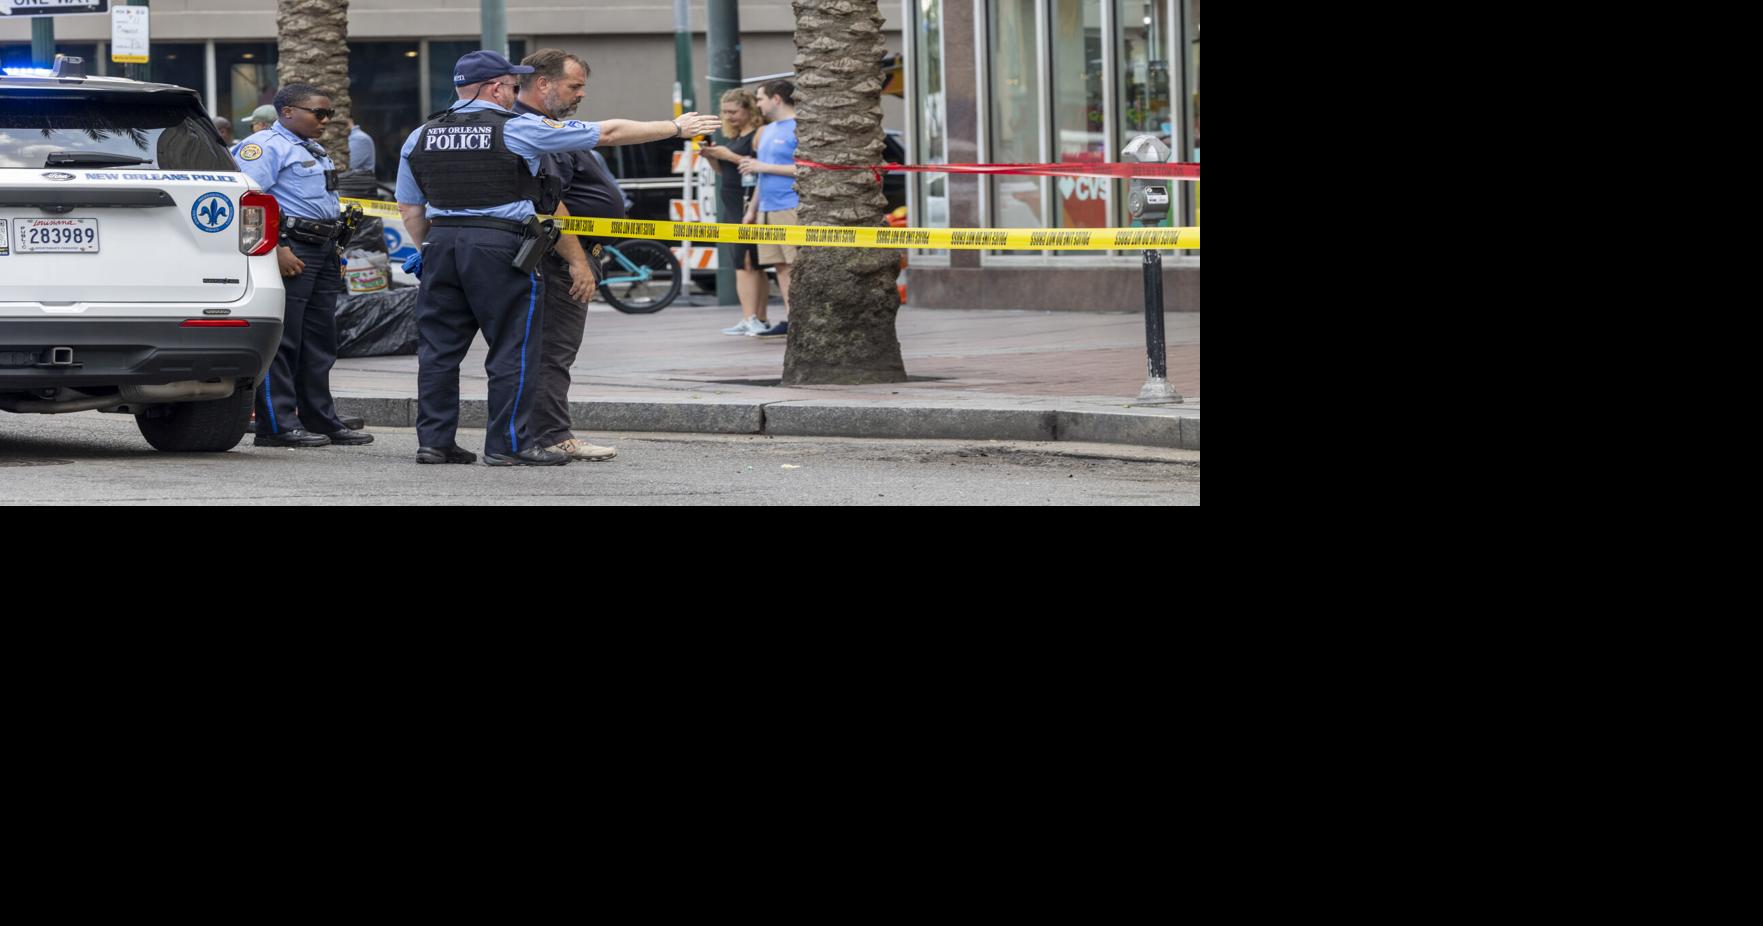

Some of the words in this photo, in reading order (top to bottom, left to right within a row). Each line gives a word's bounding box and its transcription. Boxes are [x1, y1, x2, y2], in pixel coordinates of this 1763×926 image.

[424, 134, 491, 150] POLICE
[86, 172, 119, 180] NEW
[122, 173, 190, 181] ORLEANS
[191, 173, 238, 183] POLICE
[33, 219, 76, 227] Louisiana
[29, 228, 95, 244] 283989
